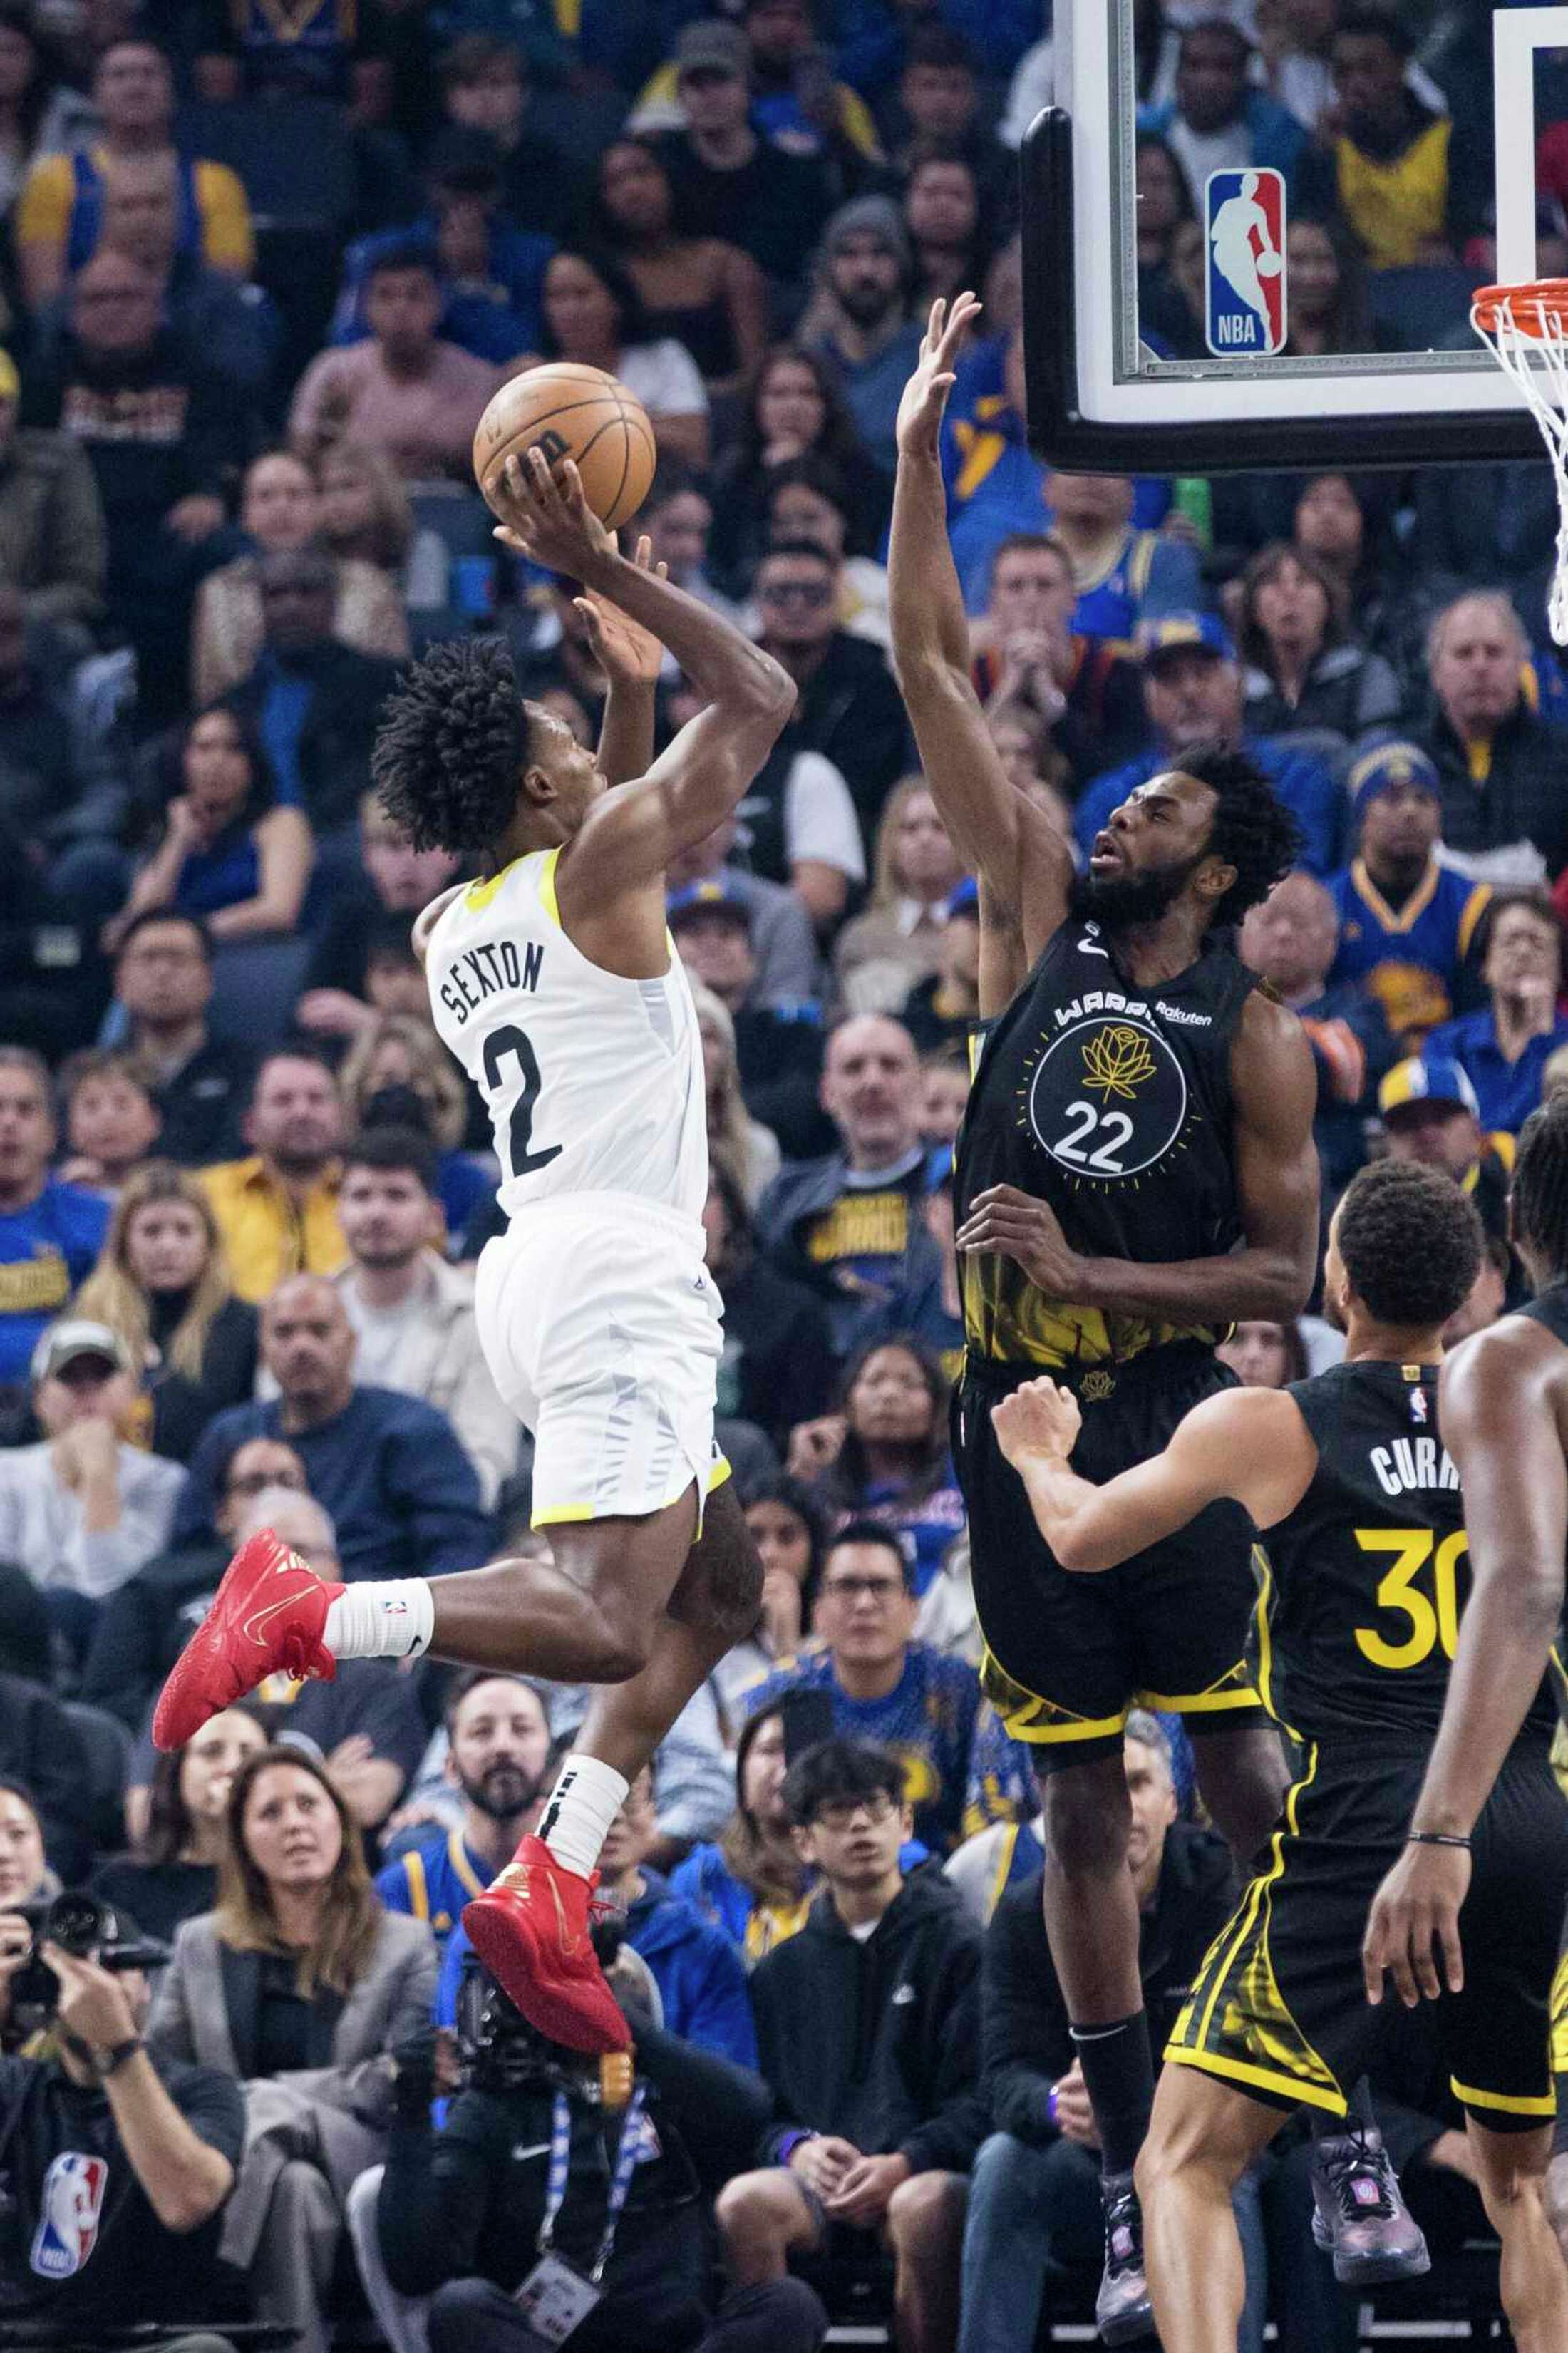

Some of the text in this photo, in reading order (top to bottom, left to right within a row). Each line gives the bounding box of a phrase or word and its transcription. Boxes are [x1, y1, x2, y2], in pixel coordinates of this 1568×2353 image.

[1218, 314, 1256, 344] NBA
[440, 941, 544, 1025] SEXTON
[1054, 991, 1163, 1038] WARR
[1155, 1000, 1212, 1026] Rakuten
[483, 1024, 563, 1178] 2
[1053, 1101, 1133, 1173] 22
[1370, 1437, 1463, 1495] CURR
